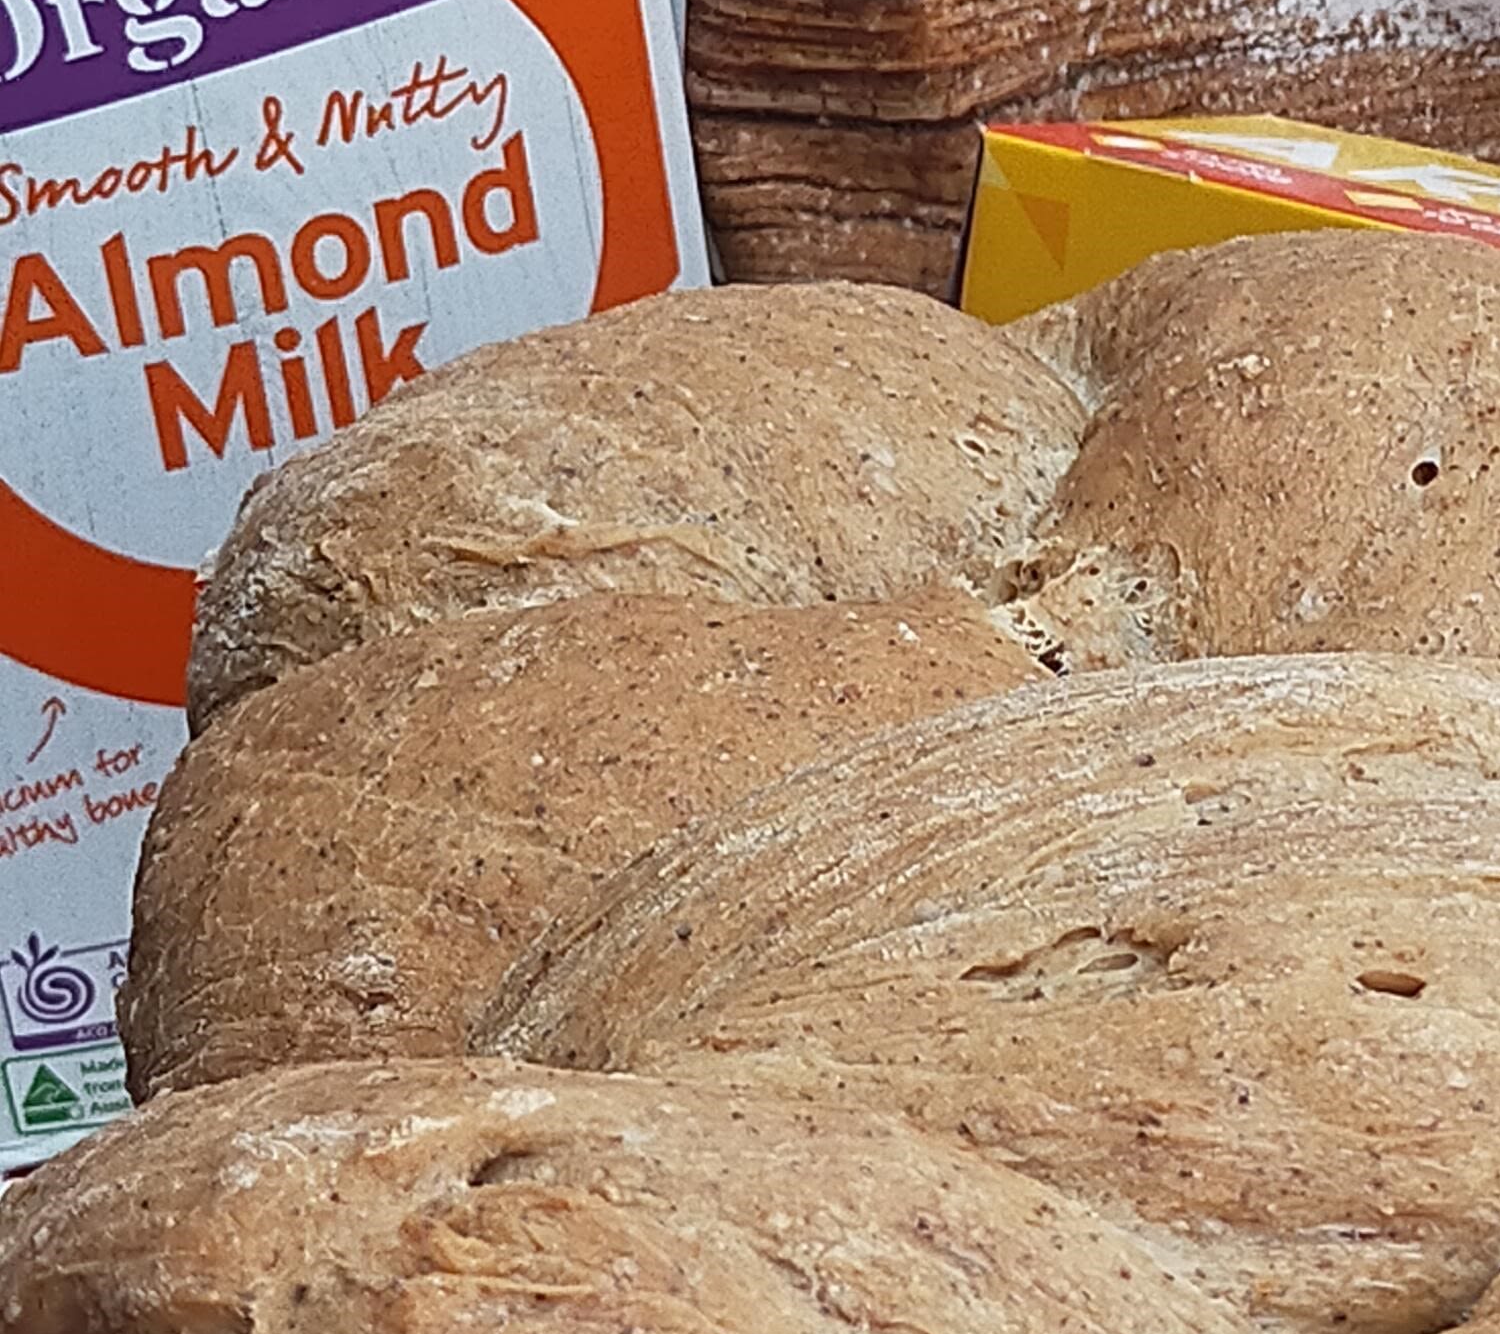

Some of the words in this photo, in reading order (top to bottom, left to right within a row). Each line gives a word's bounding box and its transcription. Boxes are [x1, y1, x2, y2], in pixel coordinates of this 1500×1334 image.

[0, 125, 240, 225] Smooth
[254, 96, 304, 175] &
[316, 54, 509, 151] Nutty
[0, 129, 541, 372] Almond
[143, 306, 429, 472] Milk
[0, 768, 85, 814] cium
[94, 741, 144, 778] for
[83, 780, 158, 825] bone
